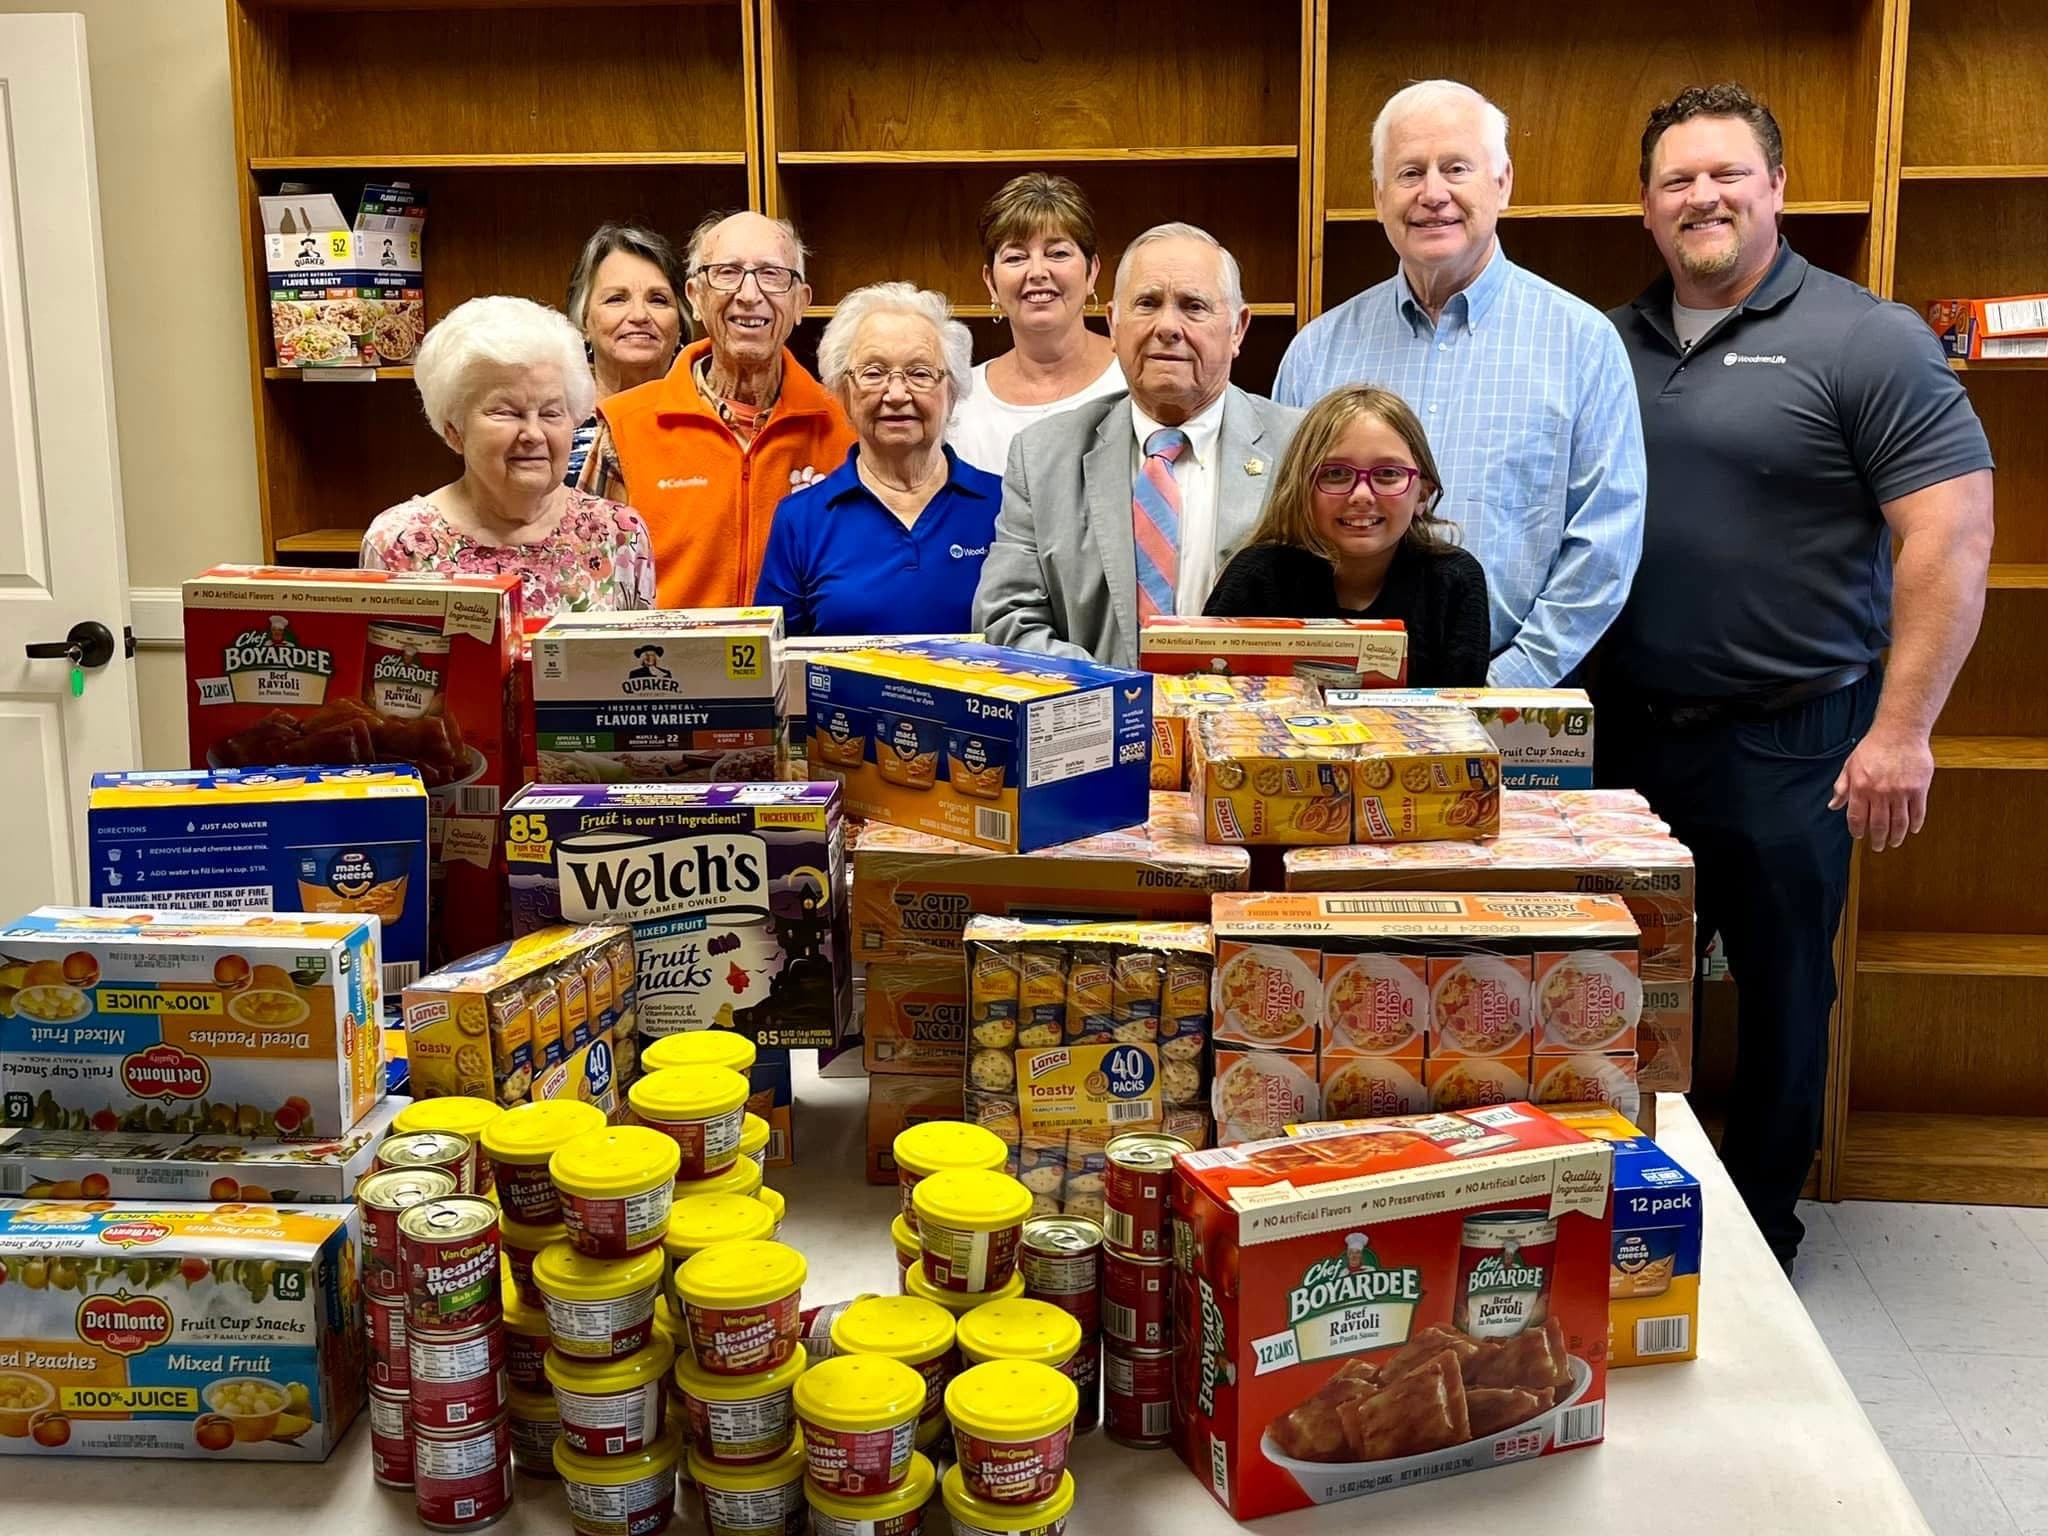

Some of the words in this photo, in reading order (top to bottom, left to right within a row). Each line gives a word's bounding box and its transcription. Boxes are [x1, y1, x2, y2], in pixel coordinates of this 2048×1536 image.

[333, 239, 346, 252] 52
[294, 258, 325, 267] QUAKER
[310, 277, 342, 286] VARIETY
[202, 590, 215, 598] NO
[215, 591, 248, 600] Artificial
[249, 592, 275, 601] Flavors
[305, 595, 353, 603] Preservatives
[235, 630, 266, 648] Chef
[225, 647, 333, 675] BOYARDEE
[732, 645, 755, 667] 52
[269, 671, 289, 681] Beef
[373, 662, 440, 687] BOYARDEE
[202, 685, 212, 698] 12
[212, 684, 231, 698] CANS
[257, 678, 300, 692] Ravioli
[622, 678, 680, 694] QUAKER
[384, 689, 422, 704] Ravioli
[966, 698, 979, 713] 12
[982, 703, 1013, 720] pack
[596, 714, 647, 726] FLAVOR
[652, 713, 709, 725] VARIETY
[1568, 714, 1584, 728] 16
[1154, 719, 1172, 757] Lance
[1499, 747, 1522, 758] Fruit
[1525, 747, 1546, 759] Cup
[1550, 747, 1586, 758] Snacks
[580, 812, 619, 831] Fruit
[622, 816, 632, 826] is
[635, 815, 655, 826] our
[1216, 799, 1237, 839] Lance
[1251, 799, 1264, 837] Toasty
[1366, 798, 1386, 838] Lance
[1401, 797, 1412, 834] Toasty
[98, 826, 147, 834] DIRECTIONS
[200, 823, 219, 831] JUST
[242, 821, 268, 829] WATER
[508, 814, 548, 842] 85
[135, 849, 142, 859] 1
[136, 871, 145, 881] 2
[336, 864, 361, 872] mac
[362, 862, 371, 871] &
[566, 843, 761, 911] Welch's
[107, 894, 148, 904] WARNING:
[151, 893, 172, 902] HELP
[175, 891, 211, 900] PREVENT
[213, 889, 233, 898] RISK
[235, 888, 245, 897] OF
[248, 888, 268, 896] FIRE.
[923, 894, 968, 912] CUP
[602, 909, 640, 921] FILY
[643, 901, 684, 916] FARMER
[688, 895, 728, 907] OWNED
[1506, 910, 1556, 918] CUP
[633, 927, 668, 939] MIXED
[671, 919, 705, 933] FRUIT
[637, 943, 700, 973] Fruit
[636, 963, 713, 992] nacks
[1075, 971, 1108, 985] Lance
[106, 994, 165, 1009] JUICE
[166, 995, 211, 1011] 100%
[1266, 967, 1282, 1022] NOODLES
[1279, 983, 1294, 1014] CUP
[410, 1004, 447, 1024] Lance
[32, 1027, 71, 1044] Fruit
[77, 1028, 126, 1045] Mixed
[190, 1030, 257, 1048] Peaches
[262, 1031, 310, 1048] Diced
[757, 1030, 779, 1046] 85
[414, 1040, 451, 1055] Toasty
[590, 1044, 608, 1075] 40
[1031, 1051, 1067, 1072] Lance
[1111, 1051, 1144, 1081] 40
[2, 1064, 49, 1079] Snacks
[51, 1065, 79, 1079] Cup
[82, 1066, 113, 1079] Fruit
[128, 1065, 179, 1084] Monte
[181, 1067, 203, 1084] Del
[1028, 1084, 1075, 1097] Toasty
[1112, 1080, 1145, 1093] PACKS
[10, 1101, 28, 1117] 16
[1279, 1088, 1293, 1119] CUP
[1465, 1182, 1479, 1193] NO
[1481, 1176, 1518, 1190] Artificial
[1519, 1173, 1546, 1185] Colors
[1561, 1170, 1603, 1185] Quality
[1373, 1198, 1388, 1209] NO
[1390, 1189, 1447, 1207] Preservatives
[1556, 1184, 1604, 1197] Ingredients
[1630, 1198, 1649, 1212] 12
[1652, 1193, 1692, 1215] pack
[1264, 1216, 1278, 1228] NO
[1279, 1210, 1319, 1225] Artificial
[1320, 1206, 1352, 1219] Flavors
[1619, 1245, 1638, 1254] mac
[1639, 1244, 1647, 1252] &
[426, 1243, 495, 1282] Beanee
[1476, 1256, 1502, 1272] Chef
[279, 1272, 299, 1289] 16
[426, 1256, 497, 1296] Weenee
[1303, 1259, 1344, 1287] Chef
[1468, 1267, 1544, 1293] BOYARDEE
[279, 1289, 300, 1298] Cups
[1290, 1268, 1421, 1322] BOYARDEE
[1493, 1294, 1513, 1305] Beef
[1344, 1307, 1368, 1320] Beef
[1479, 1302, 1522, 1318] Ravioli
[86, 1312, 113, 1329] Del
[114, 1312, 165, 1331] Monte
[181, 1317, 216, 1332] Fruit
[220, 1316, 250, 1334] Cup
[256, 1317, 306, 1334] Snacks
[1330, 1313, 1380, 1337] Ravioli
[107, 1333, 142, 1347] Quality
[715, 1317, 776, 1345] Beanee
[715, 1329, 777, 1357] Weenee
[1198, 1275, 1216, 1418] BOYARDEE
[25, 1352, 97, 1371] Peaches
[732, 1350, 765, 1365] Original
[1259, 1346, 1273, 1365] 12
[1273, 1340, 1294, 1361] CANS
[168, 1355, 224, 1373] Mixed
[228, 1355, 273, 1374] Fruit
[74, 1391, 123, 1408] 100%
[123, 1391, 189, 1409] JUICE
[981, 1453, 1043, 1475] Beanee
[981, 1465, 1044, 1486] Weenee
